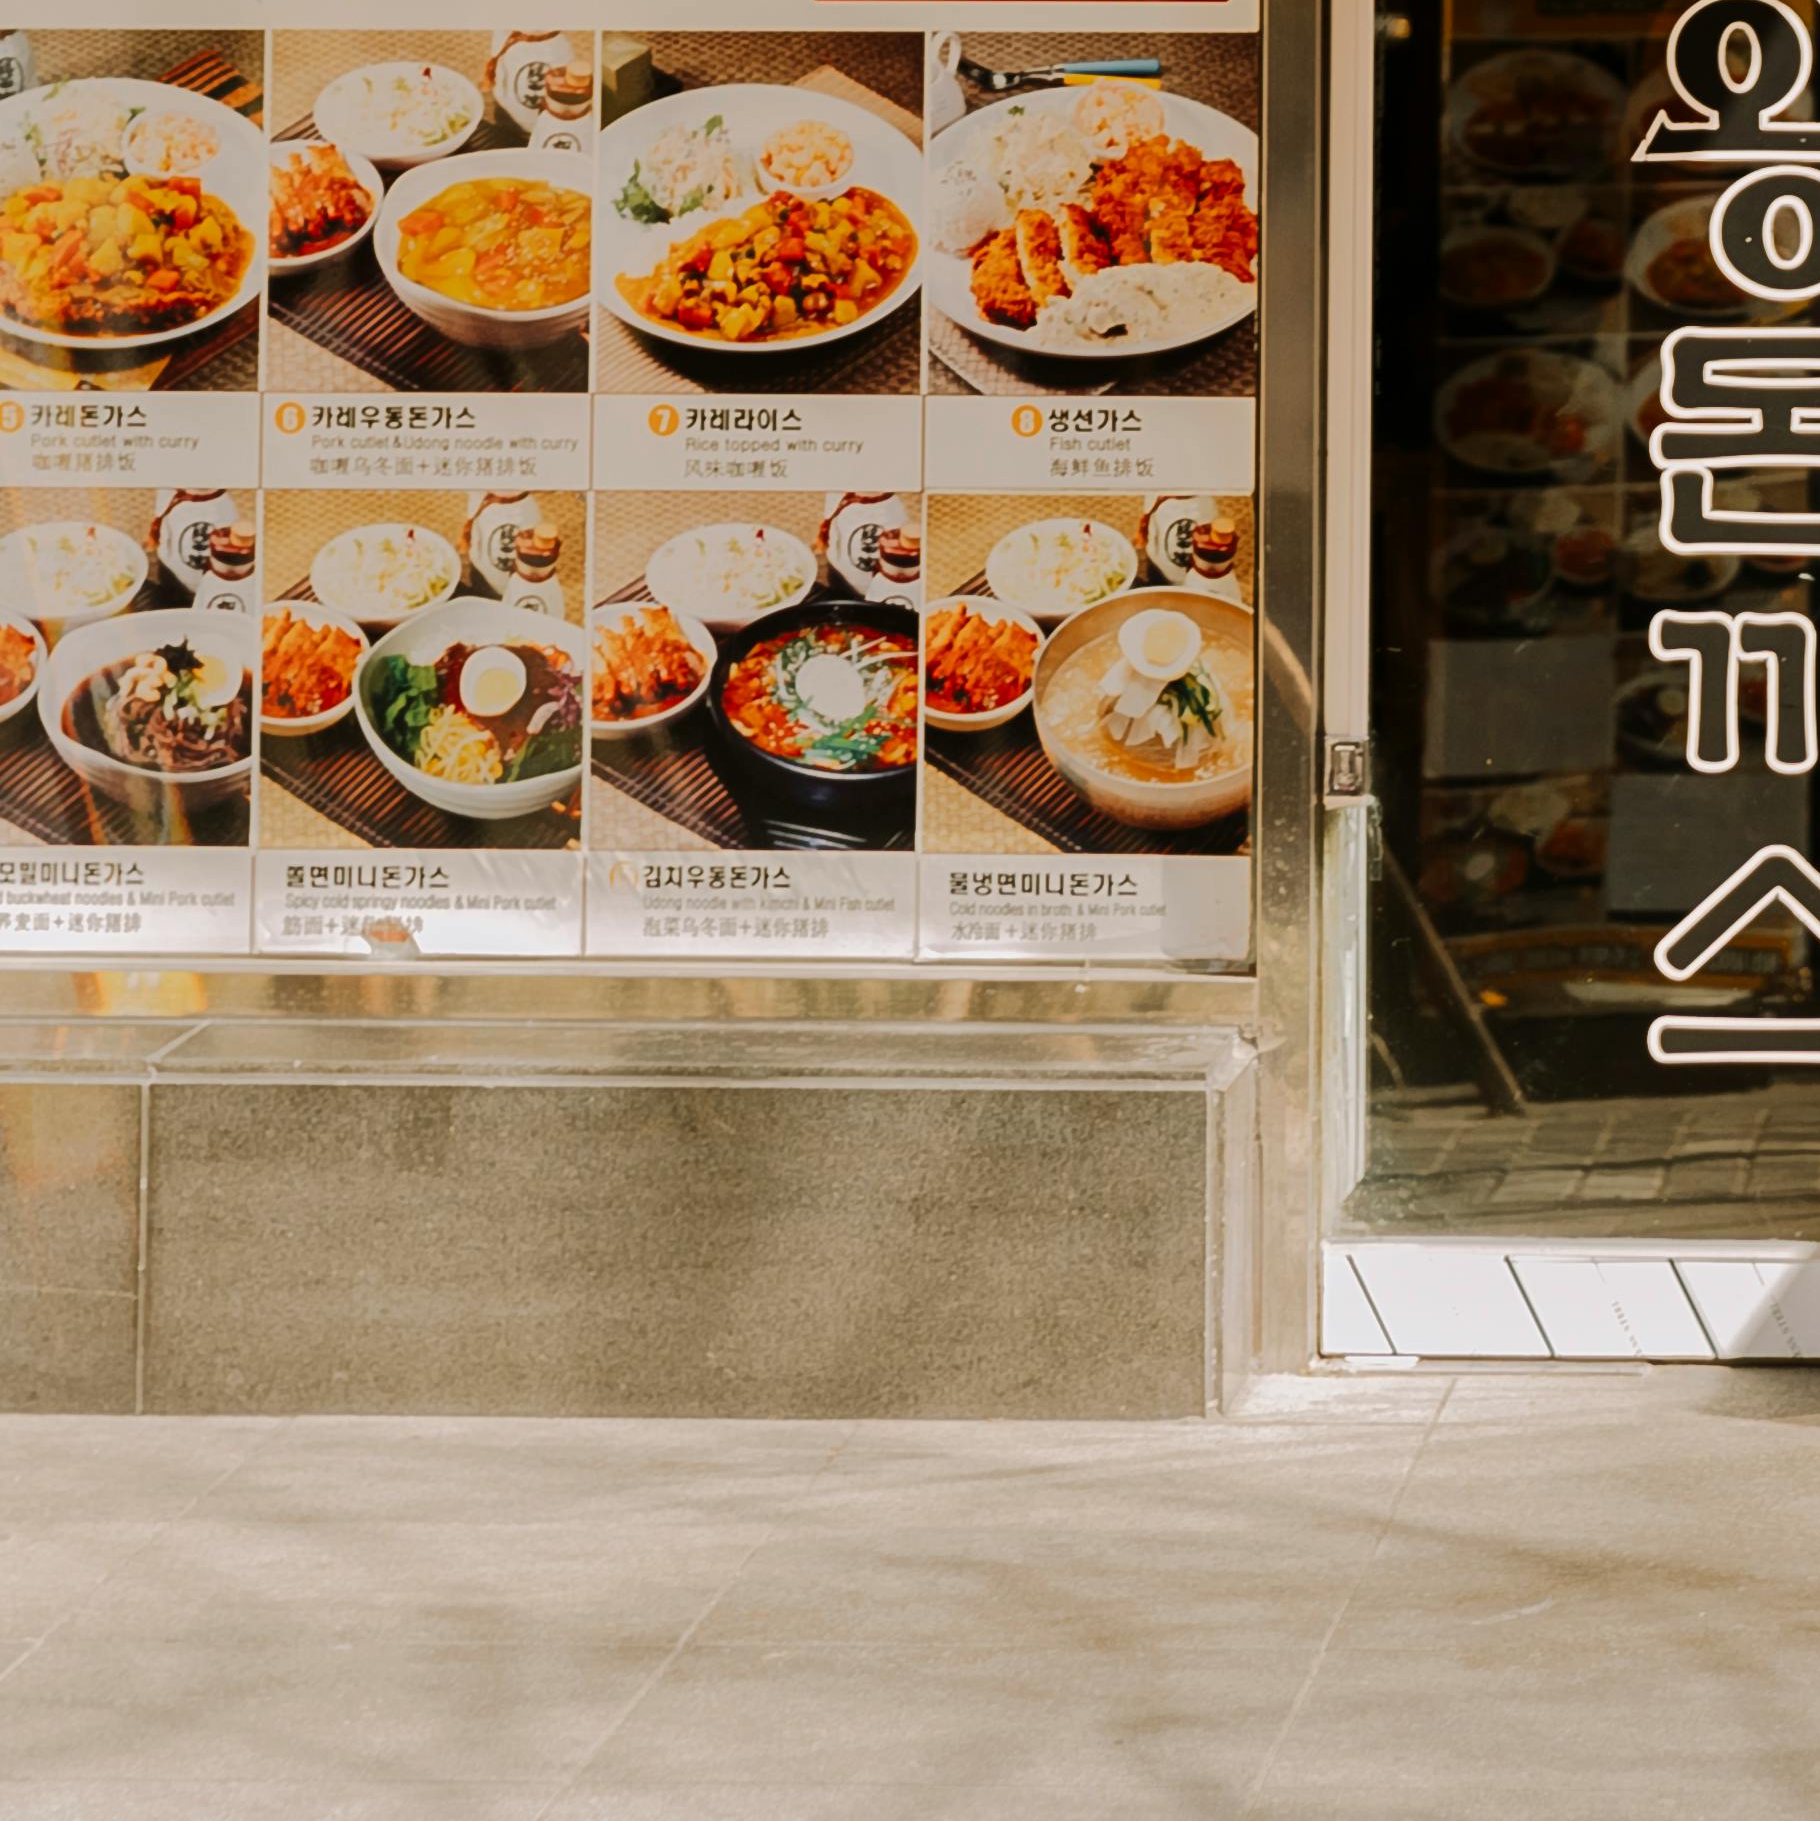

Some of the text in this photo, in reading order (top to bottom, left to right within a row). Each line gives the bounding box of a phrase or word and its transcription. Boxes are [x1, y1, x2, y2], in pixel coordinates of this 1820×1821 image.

[30, 404, 148, 428] 카레돈가스
[311, 405, 476, 429] 카레우동돈가스
[685, 408, 802, 431] 카레라이스
[1048, 409, 1142, 433] 생선가스
